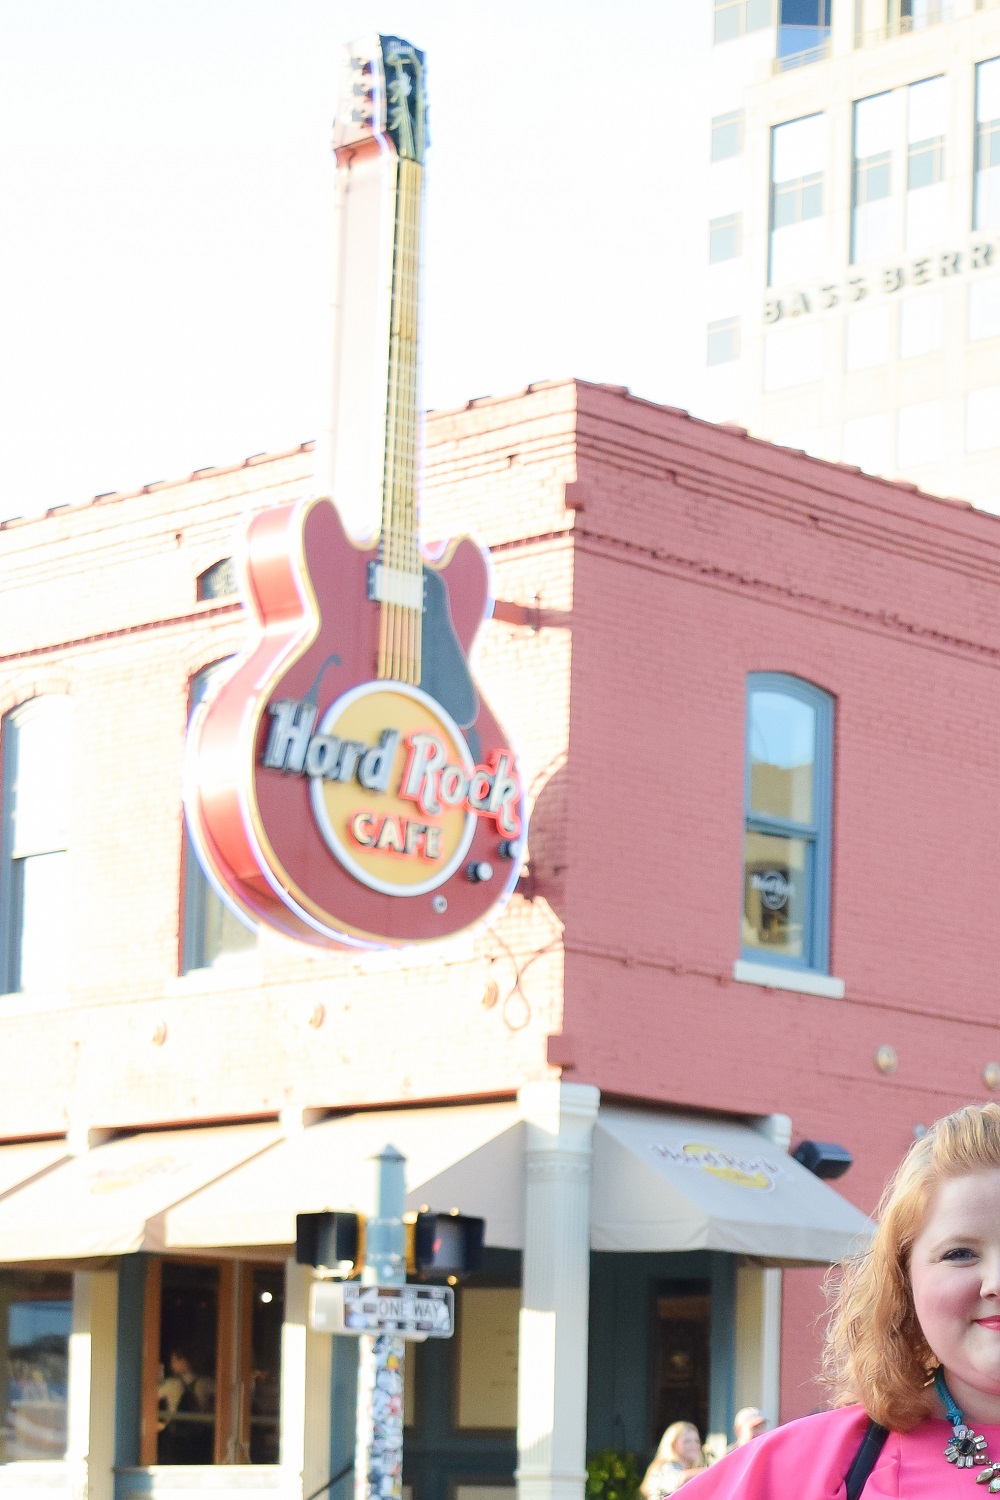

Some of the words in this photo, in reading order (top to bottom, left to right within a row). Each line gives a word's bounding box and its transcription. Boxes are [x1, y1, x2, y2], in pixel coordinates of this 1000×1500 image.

[763, 279, 868, 325] BASS
[262, 698, 400, 793] Hard
[401, 732, 521, 838] Rock
[351, 812, 443, 860] CAFE
[413, 1300, 441, 1318] WAY
